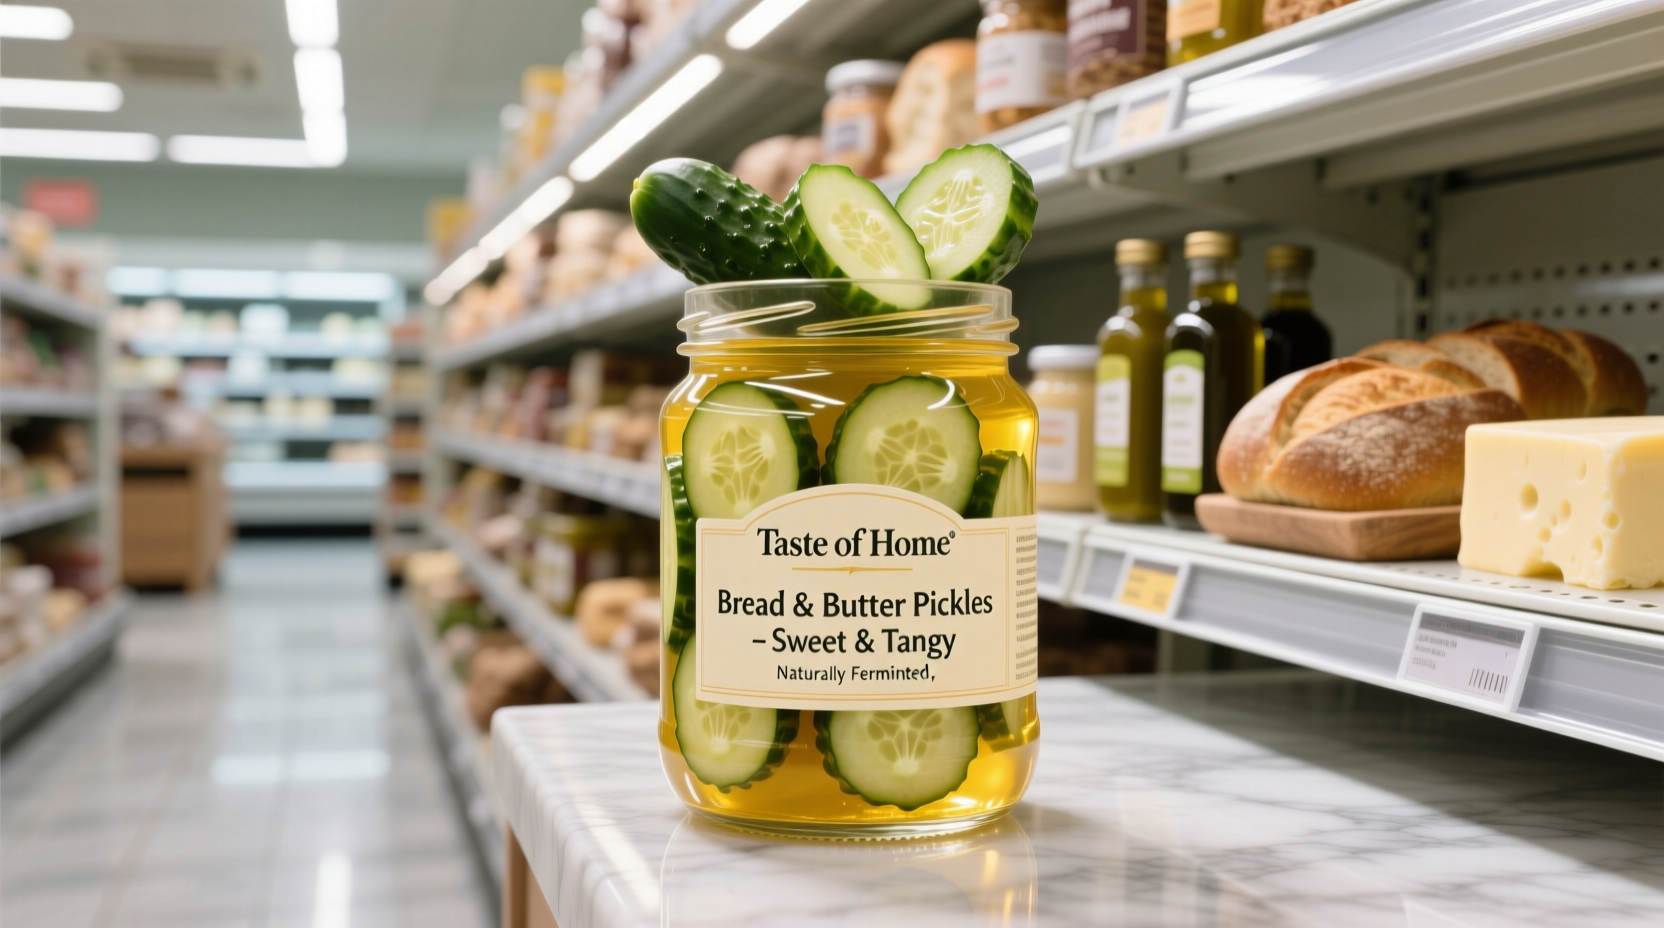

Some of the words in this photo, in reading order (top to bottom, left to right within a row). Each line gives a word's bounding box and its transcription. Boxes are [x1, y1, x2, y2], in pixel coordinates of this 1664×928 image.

[757, 527, 828, 557] Taste
[835, 527, 867, 557] of
[717, 588, 785, 616] Bread
[793, 591, 815, 618] &
[822, 592, 907, 618] Butter
[913, 588, 993, 617] Pickles
[854, 629, 875, 654] &
[881, 628, 957, 660] Tangy
[777, 664, 846, 685] Naturally
